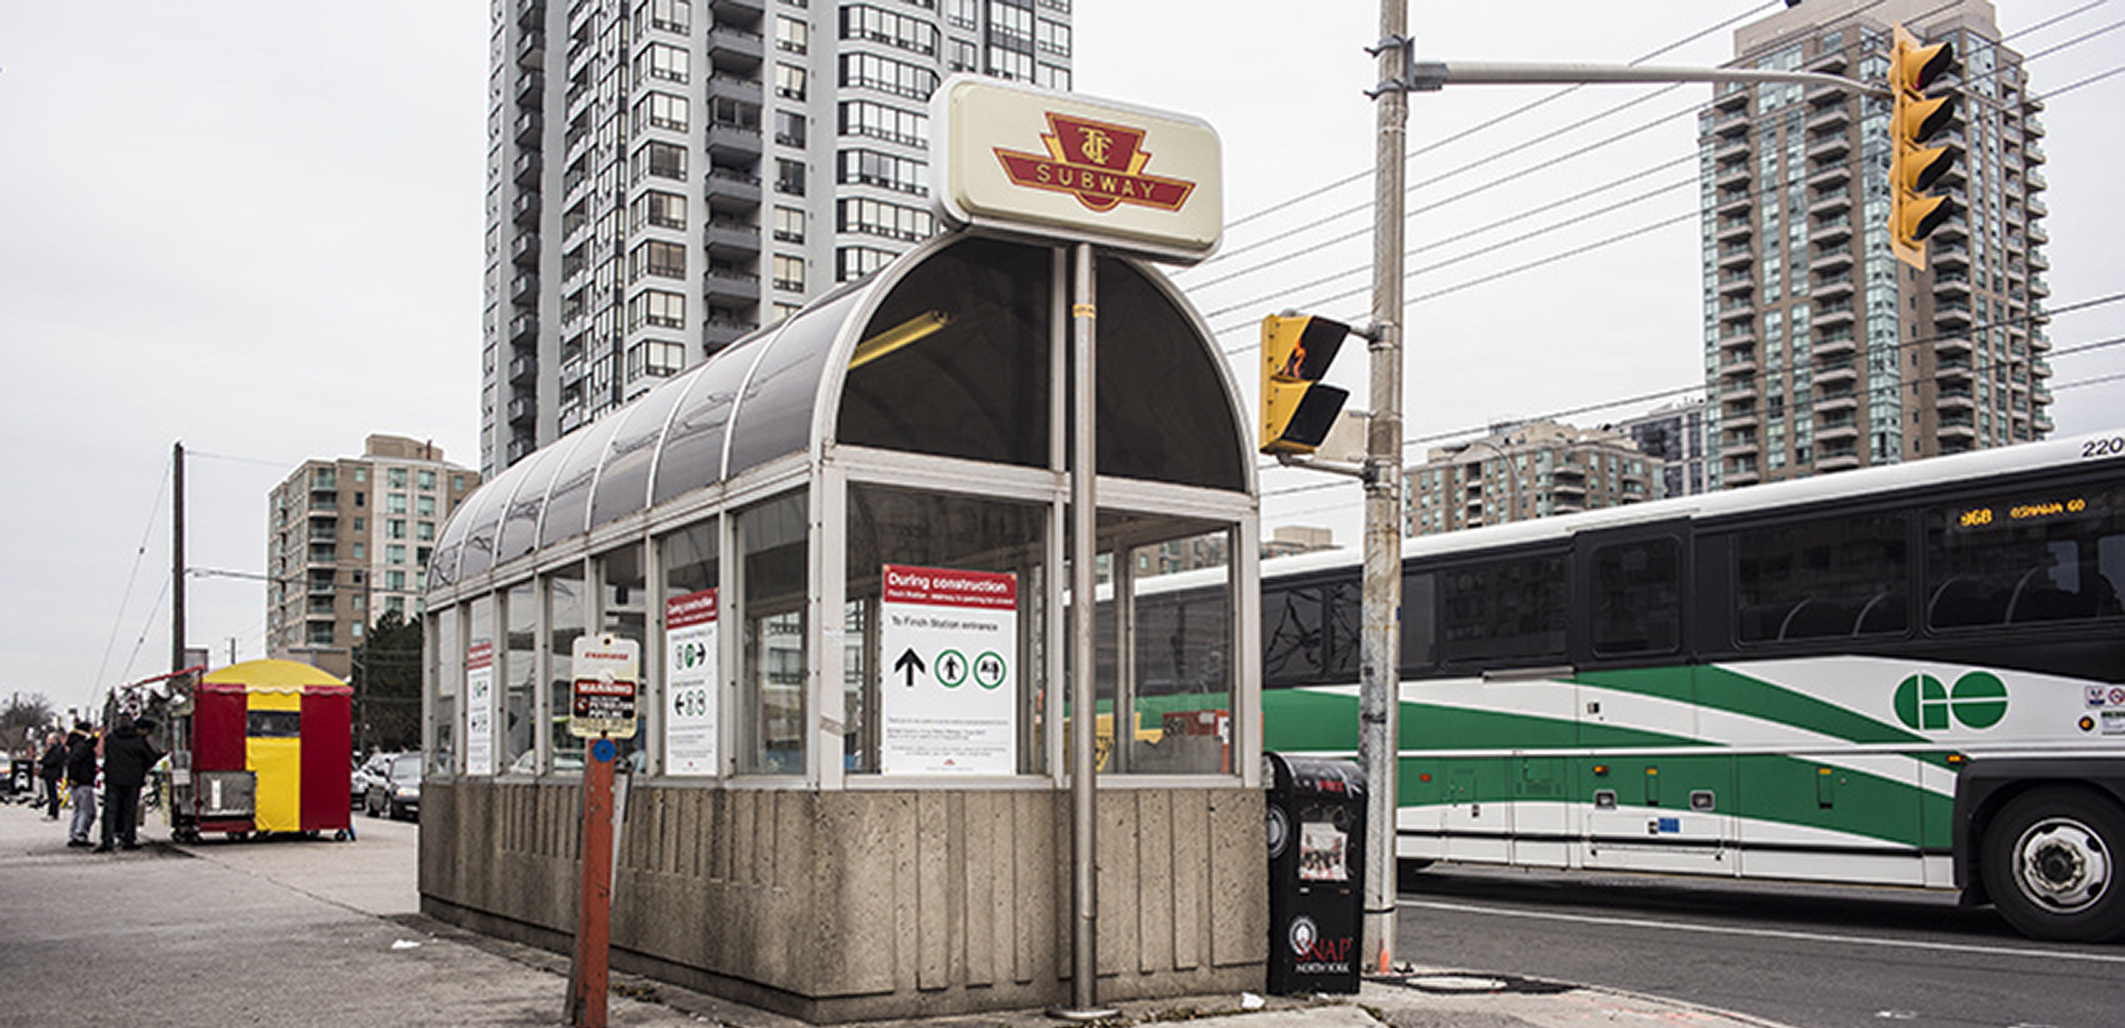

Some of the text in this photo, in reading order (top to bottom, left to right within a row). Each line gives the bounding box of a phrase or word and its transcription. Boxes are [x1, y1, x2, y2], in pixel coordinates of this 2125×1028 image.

[1036, 164, 1155, 198] SUBWAY
[888, 572, 1007, 593] During construction
[892, 616, 999, 631] To Finch Station entrance
[577, 682, 634, 695] WARNING
[1296, 938, 1351, 962] SNAP
